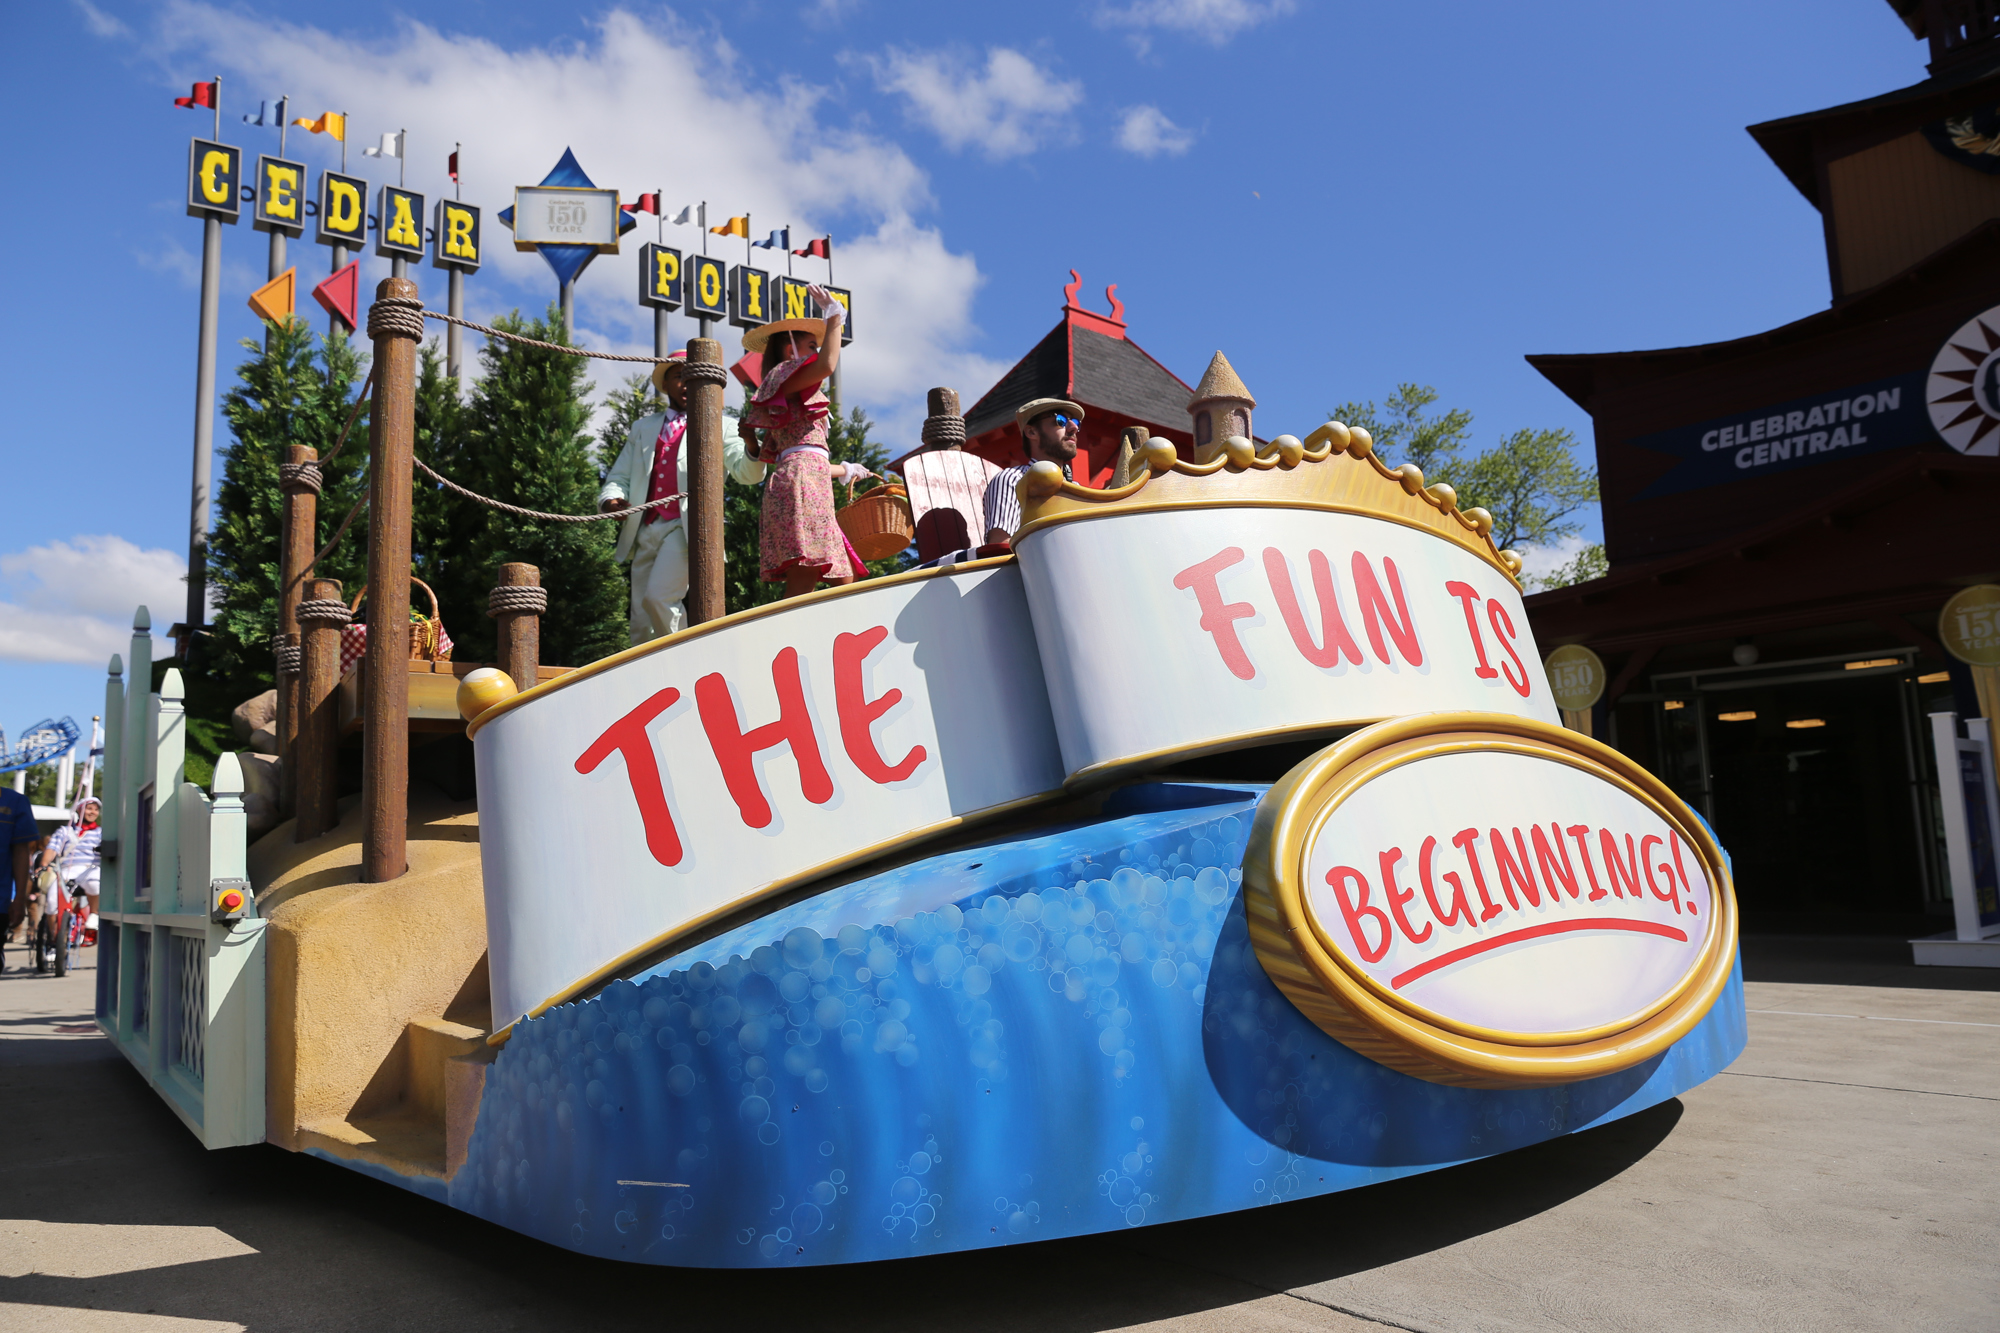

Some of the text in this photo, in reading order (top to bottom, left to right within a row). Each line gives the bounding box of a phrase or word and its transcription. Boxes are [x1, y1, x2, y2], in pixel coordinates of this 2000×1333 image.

[199, 150, 477, 260] CEDAR
[547, 205, 587, 226] 150
[549, 226, 582, 234] YEARS
[1701, 387, 1901, 452] CELEBRATION
[1734, 422, 1867, 470] CENTRAL
[1173, 546, 1531, 698] FUN IS
[1955, 610, 2000, 641] 15
[1553, 665, 1593, 689] 150
[1557, 687, 1591, 697] YEARS
[574, 625, 928, 868] THE
[1325, 822, 1698, 964] BEGINNING!
